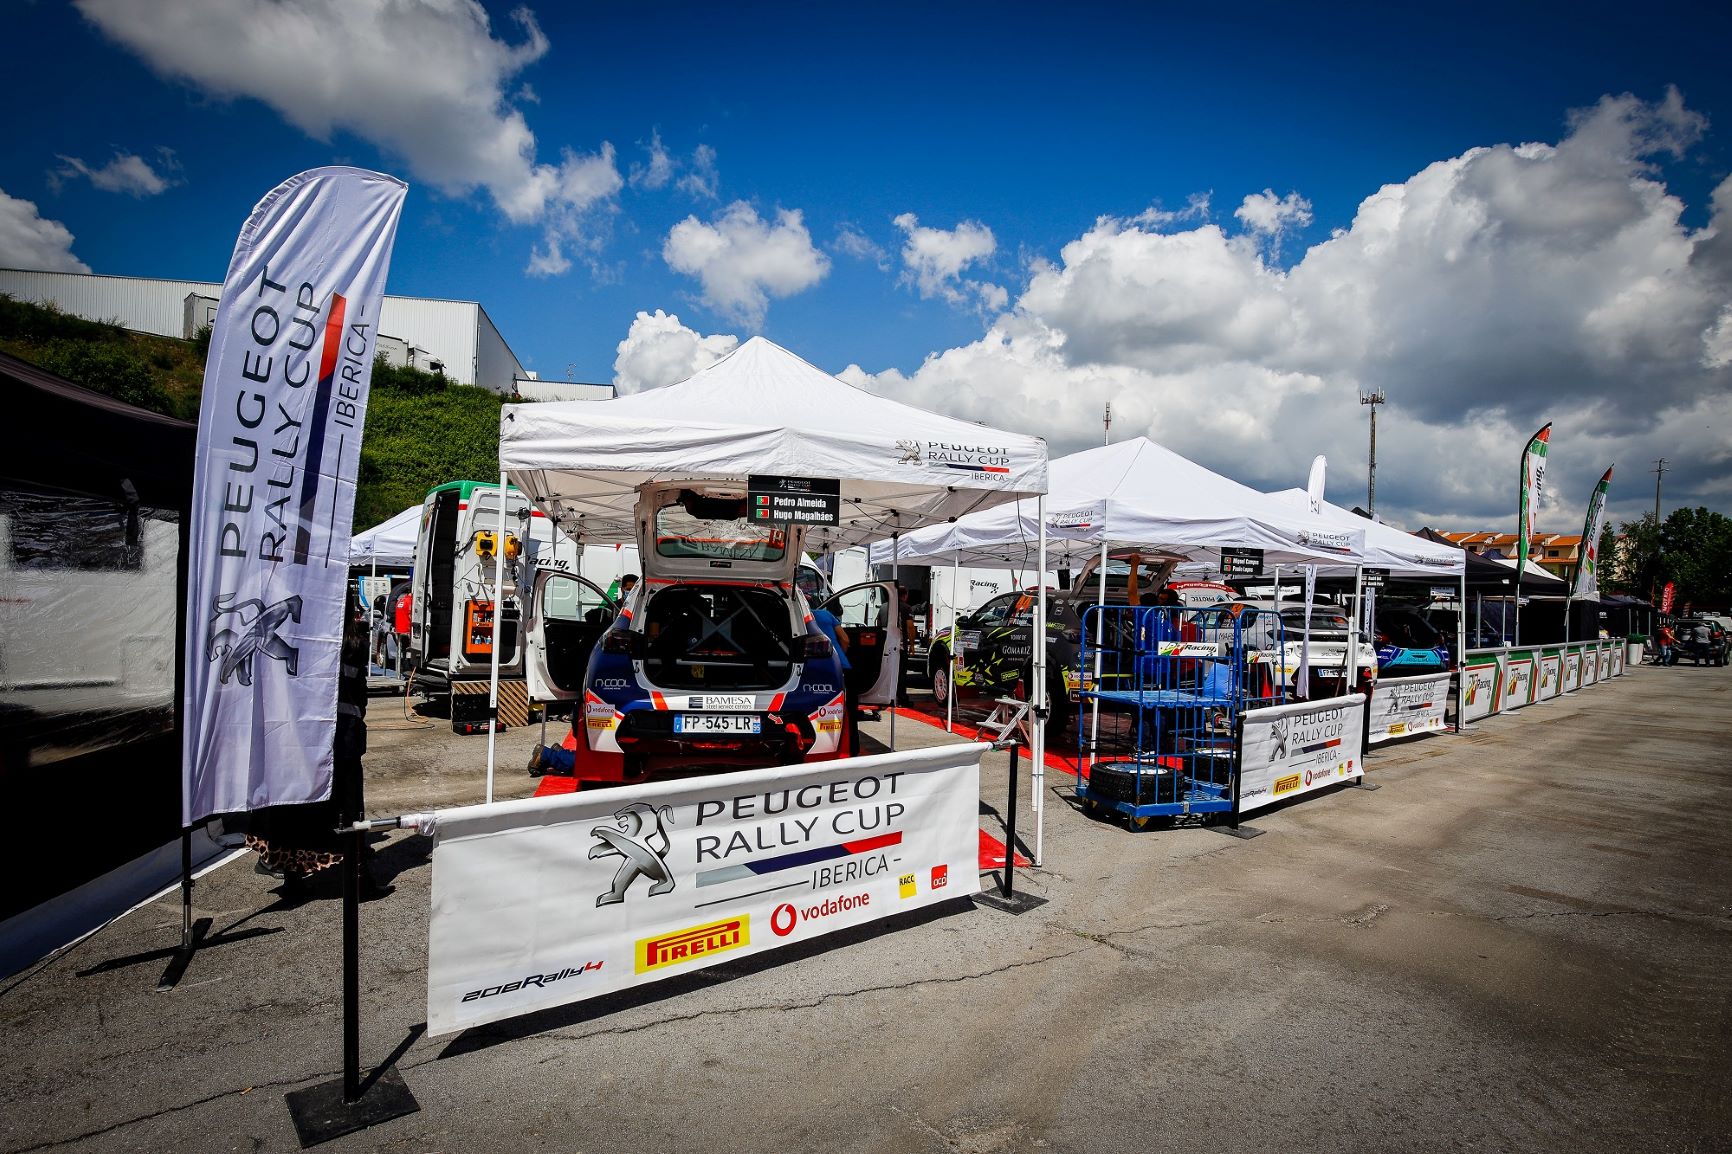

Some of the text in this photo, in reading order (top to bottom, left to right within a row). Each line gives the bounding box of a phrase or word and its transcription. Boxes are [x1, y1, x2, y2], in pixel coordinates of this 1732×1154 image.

[334, 323, 370, 428] IBERICA
[220, 265, 287, 558] PEUGEOT
[258, 281, 320, 562] RALLY CUP
[928, 441, 1010, 455] PEUGEOT
[928, 451, 1010, 466] RALLY CUP
[971, 472, 1004, 481] IBERICA
[774, 496, 827, 508] Pedro Almeida
[773, 509, 793, 520] Hugo
[1312, 532, 1351, 541] PEUGEOT
[528, 556, 569, 569] acing
[970, 579, 998, 589] Racing
[1184, 644, 1216, 653] Racing
[705, 696, 752, 704] BAMESA
[1293, 707, 1345, 727] PEUGEOT
[1291, 723, 1344, 746] RALLY CUP
[1275, 775, 1299, 793] PIRELLI
[695, 771, 905, 827] PEUGEOT
[696, 802, 905, 864] RALLY CUP
[812, 853, 889, 890] IBERICA
[646, 920, 741, 967] PIRELLI
[801, 892, 870, 921] vodafone
